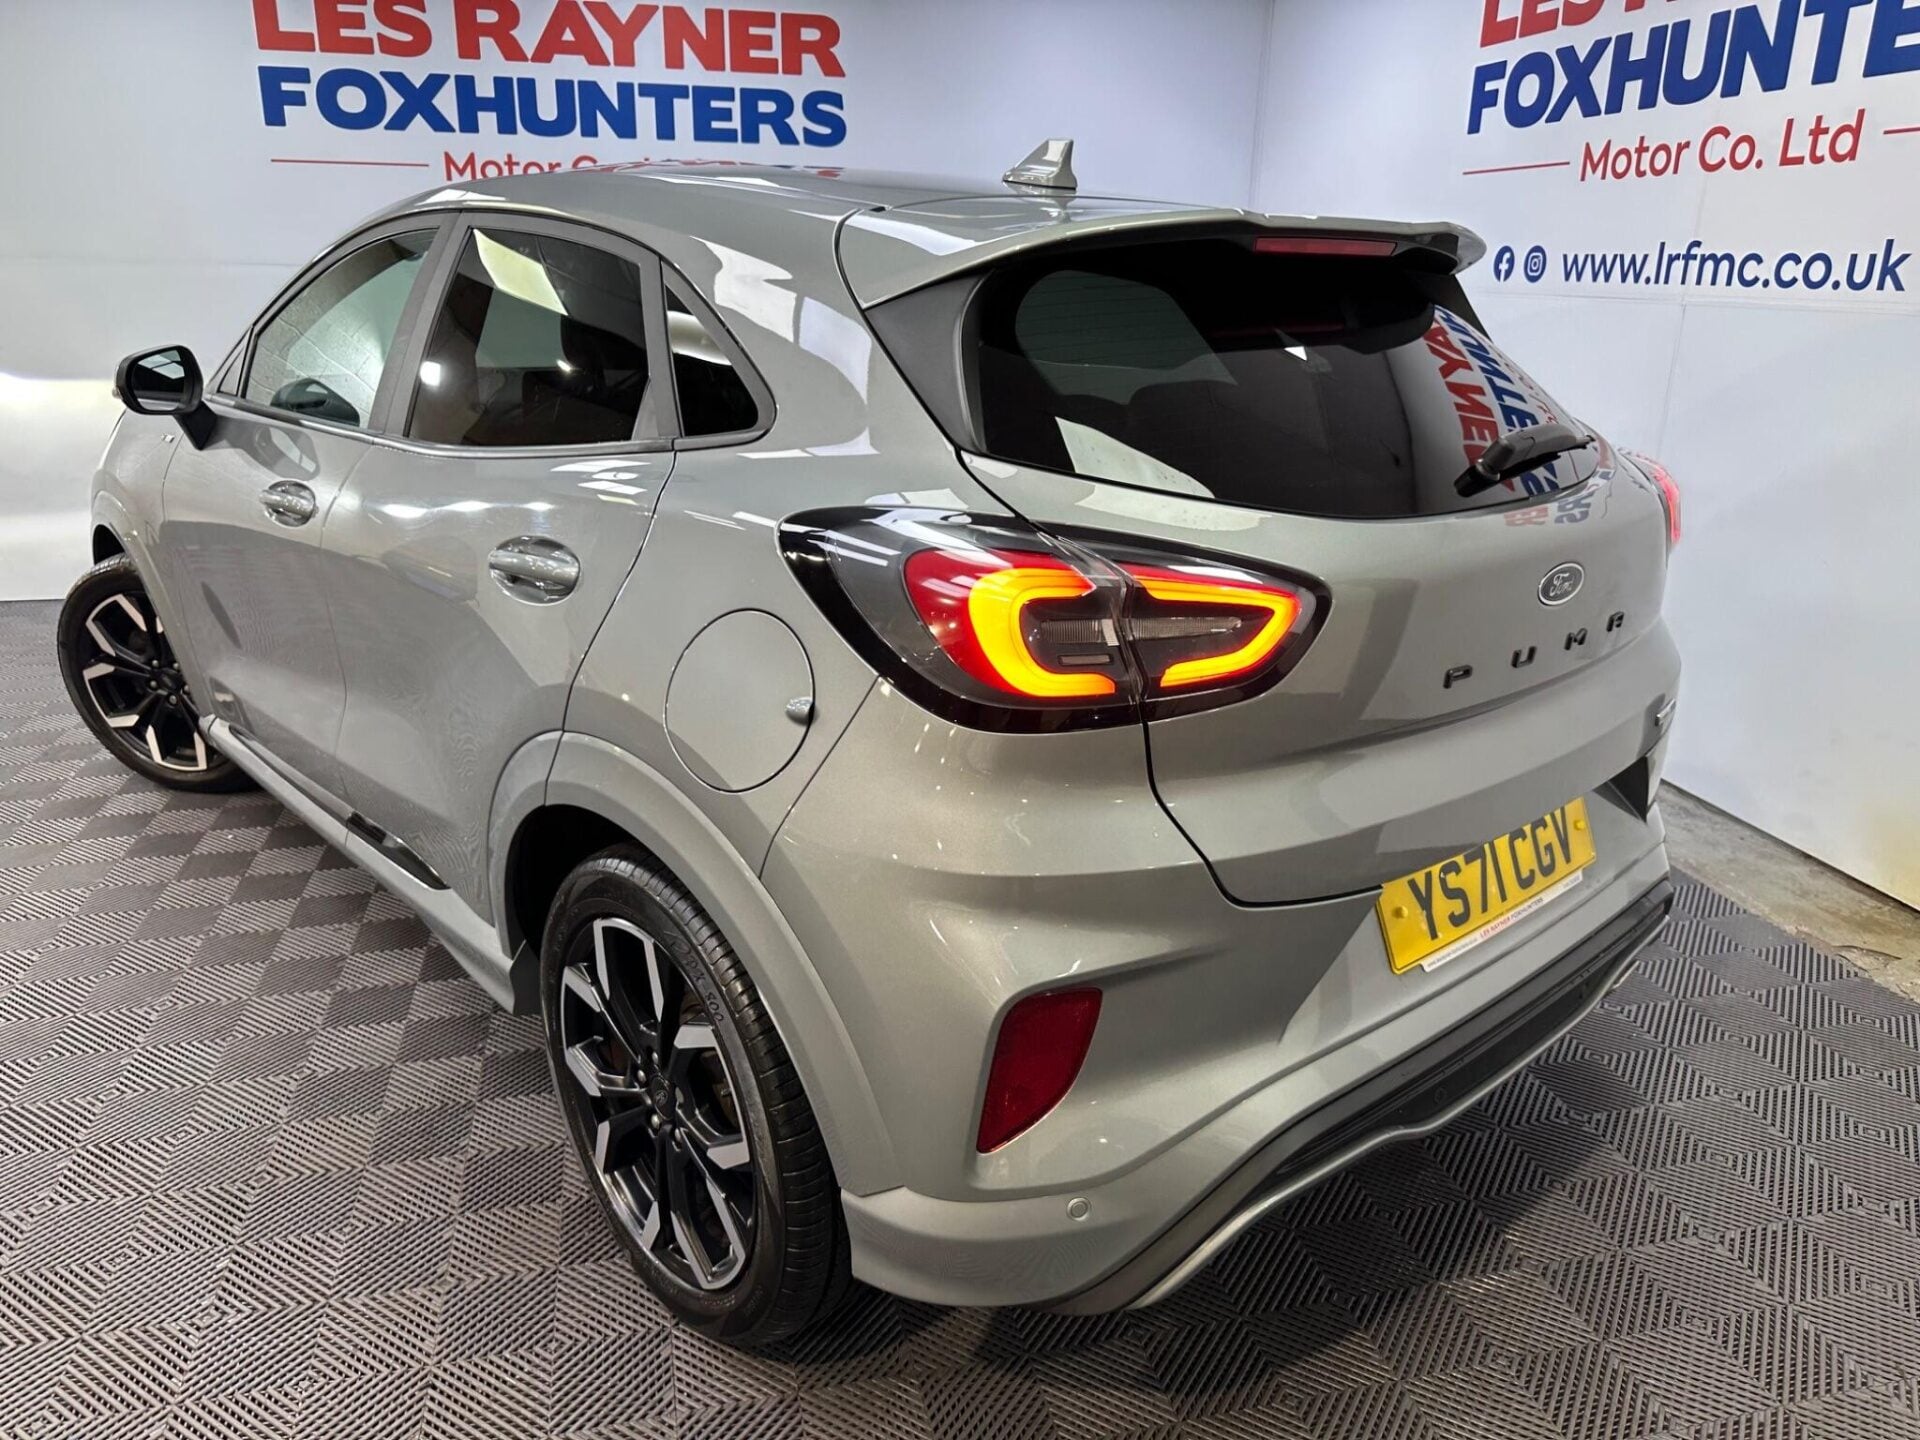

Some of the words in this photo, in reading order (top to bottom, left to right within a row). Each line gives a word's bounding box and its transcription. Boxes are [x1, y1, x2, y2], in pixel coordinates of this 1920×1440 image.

[252, 0, 433, 57] LES
[454, 0, 847, 78] RAYNER
[257, 65, 848, 148] FOXHUNTERS
[1580, 136, 1691, 182] Motor
[1699, 125, 1764, 174] Co.
[1779, 108, 1866, 167] Ltd
[1561, 238, 1912, 293] www.lrfmc.co.uk
[1549, 572, 1575, 597] Ford
[1443, 611, 1625, 689] PUMA
[1407, 840, 1508, 941] YS71
[1508, 806, 1572, 890] CGV
